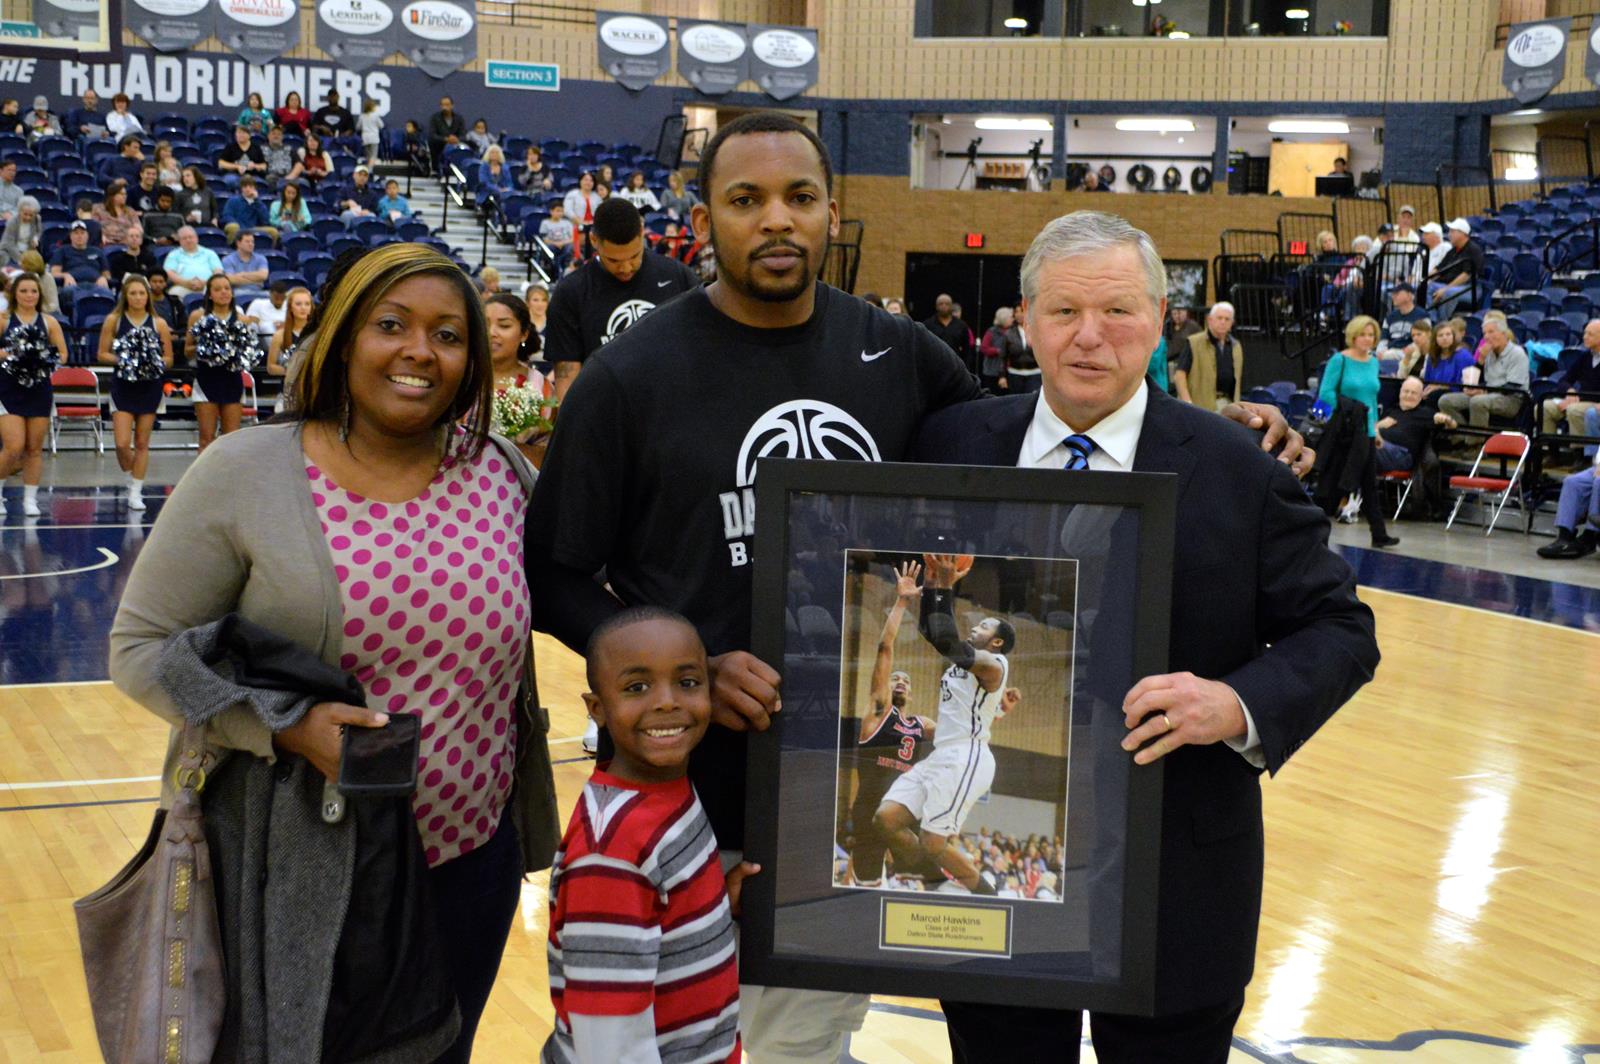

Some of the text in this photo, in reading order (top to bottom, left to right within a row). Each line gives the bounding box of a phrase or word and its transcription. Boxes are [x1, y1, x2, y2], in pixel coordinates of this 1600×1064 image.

[330, 9, 383, 22] Lexmark
[421, 10, 463, 29] FireStar
[611, 31, 657, 42] WACKER
[0, 57, 38, 83] HE
[492, 68, 553, 83] SECTION 3
[60, 53, 392, 118] ROADRUNNERS
[897, 735, 916, 761] 3
[911, 913, 981, 925] Marcel Hawkins
